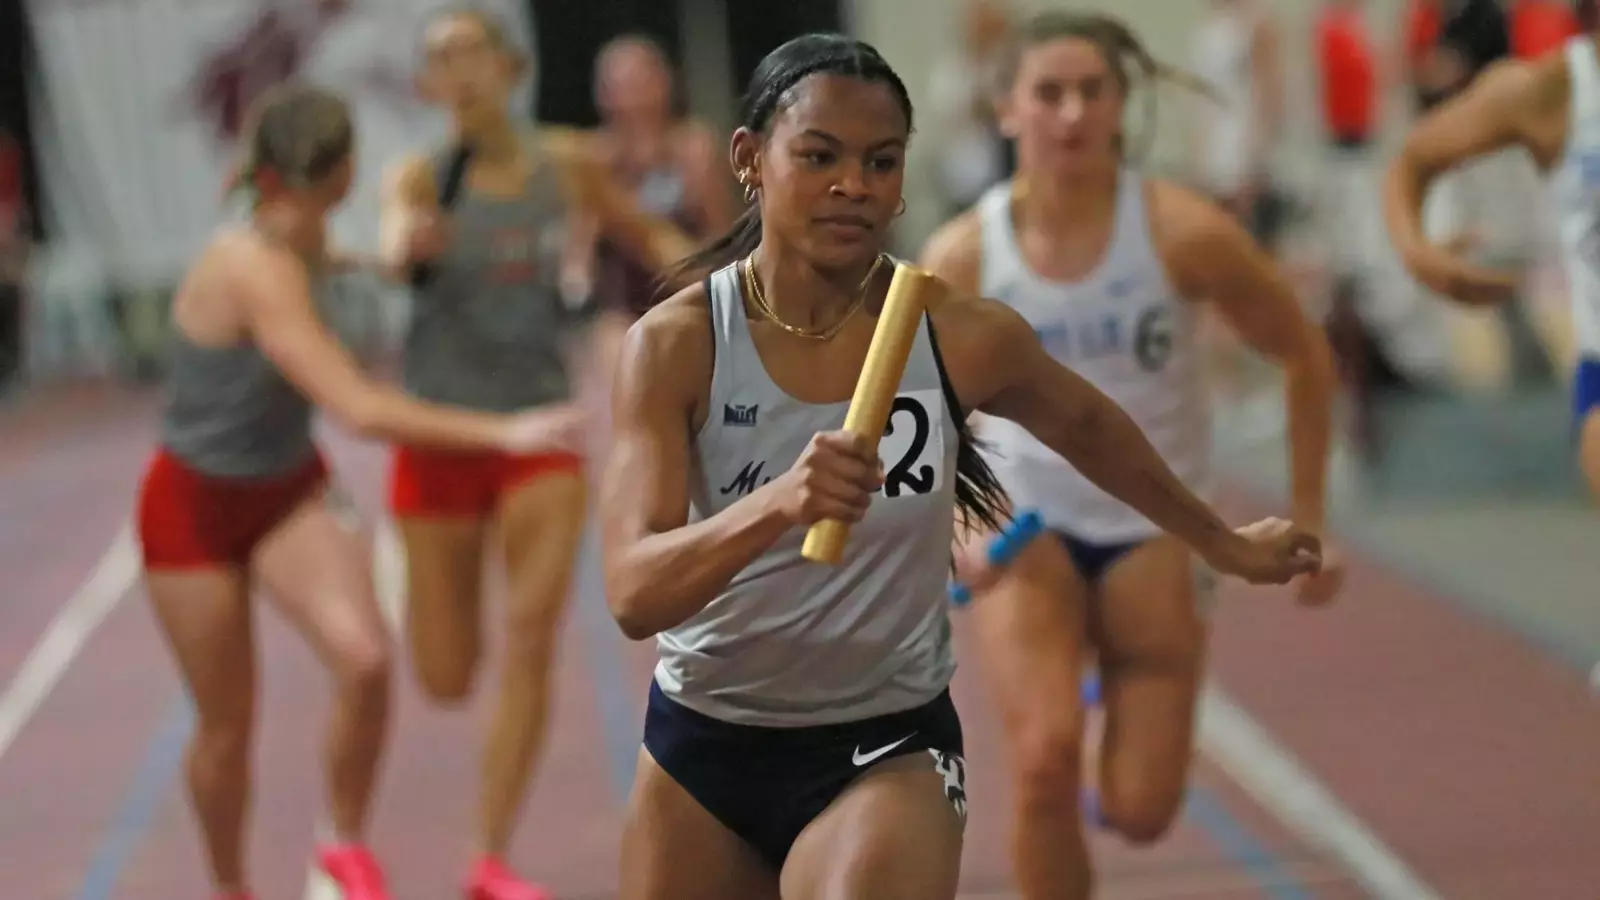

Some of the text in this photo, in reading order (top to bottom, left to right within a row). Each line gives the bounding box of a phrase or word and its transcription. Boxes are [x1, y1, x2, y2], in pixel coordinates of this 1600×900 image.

[1134, 303, 1172, 373] 6
[720, 460, 771, 496] M
[875, 397, 934, 497] 2
